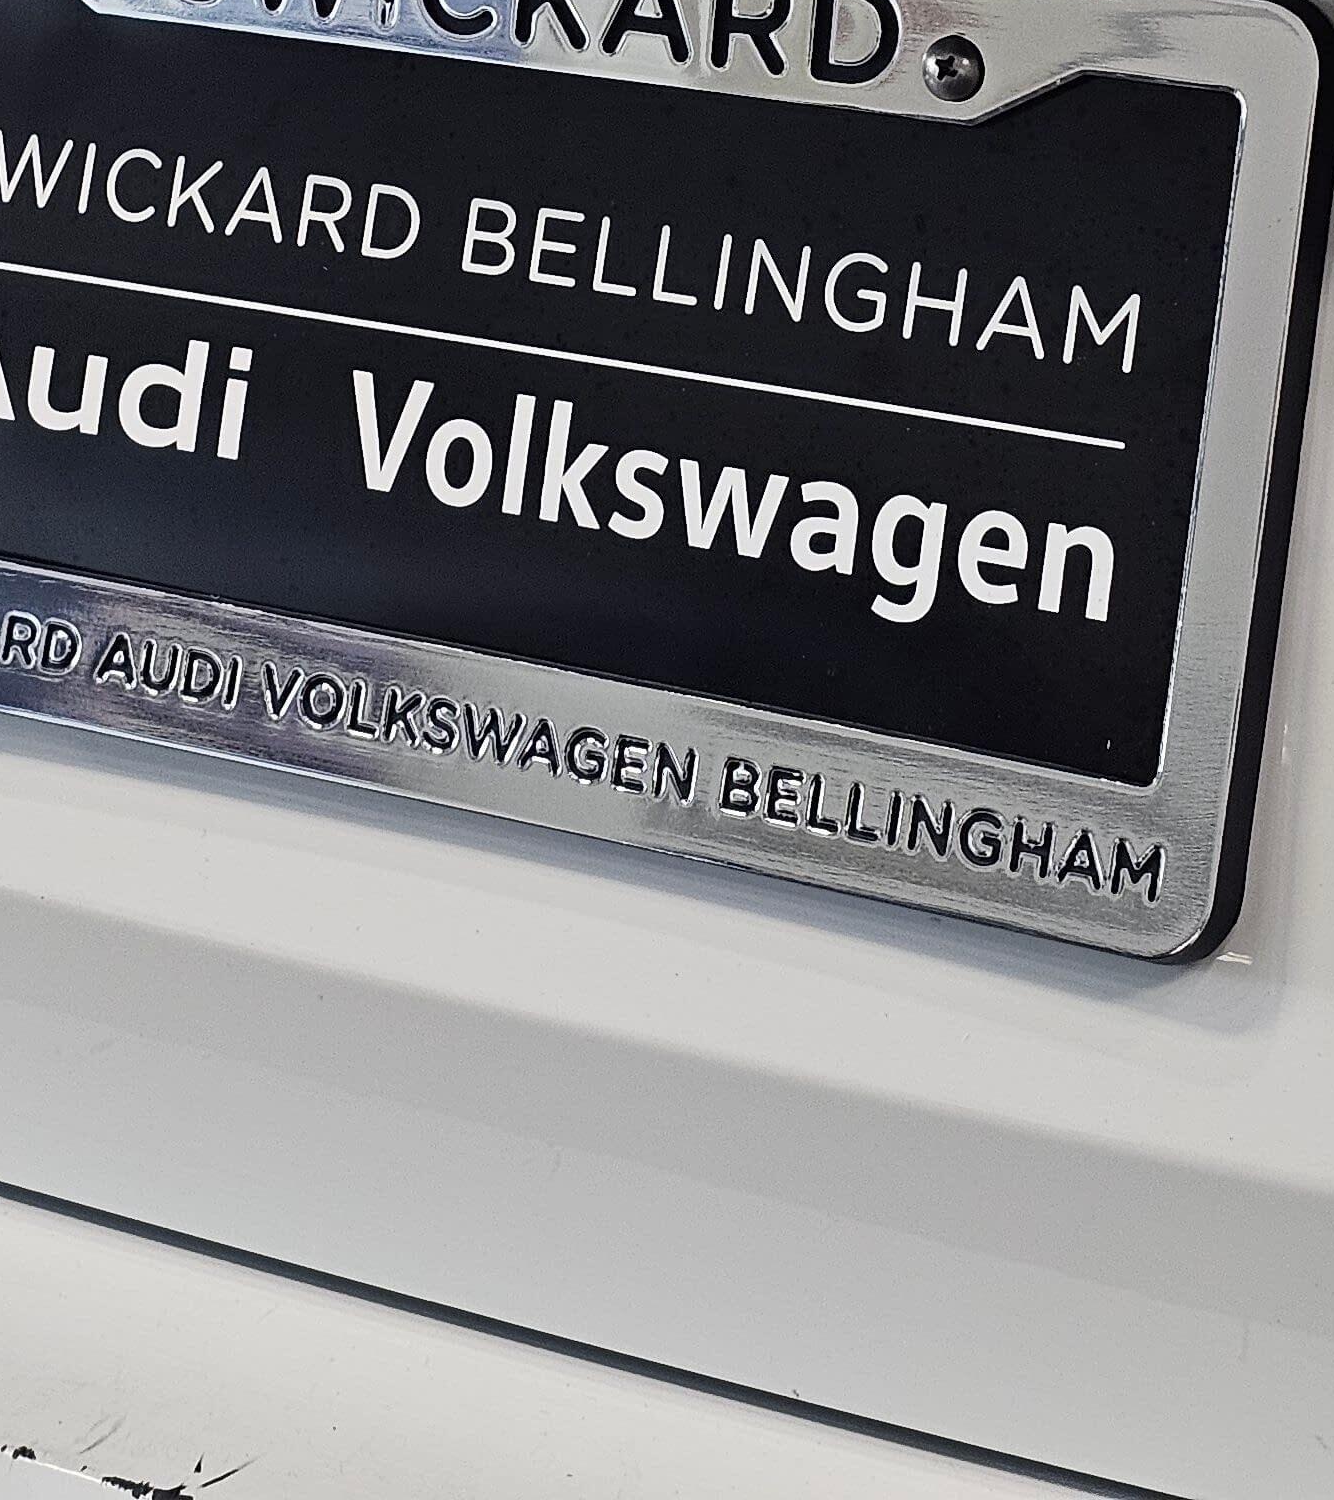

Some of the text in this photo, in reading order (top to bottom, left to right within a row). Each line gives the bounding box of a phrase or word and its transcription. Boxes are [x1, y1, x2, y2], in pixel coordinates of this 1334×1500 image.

[462, 197, 1144, 376] BELLINGHAM
[351, 368, 1116, 624] Volkswagen
[94, 631, 242, 712] AUDI
[261, 662, 698, 809] VOLKSWAGEN
[716, 757, 1170, 907] BELLINGHAM
